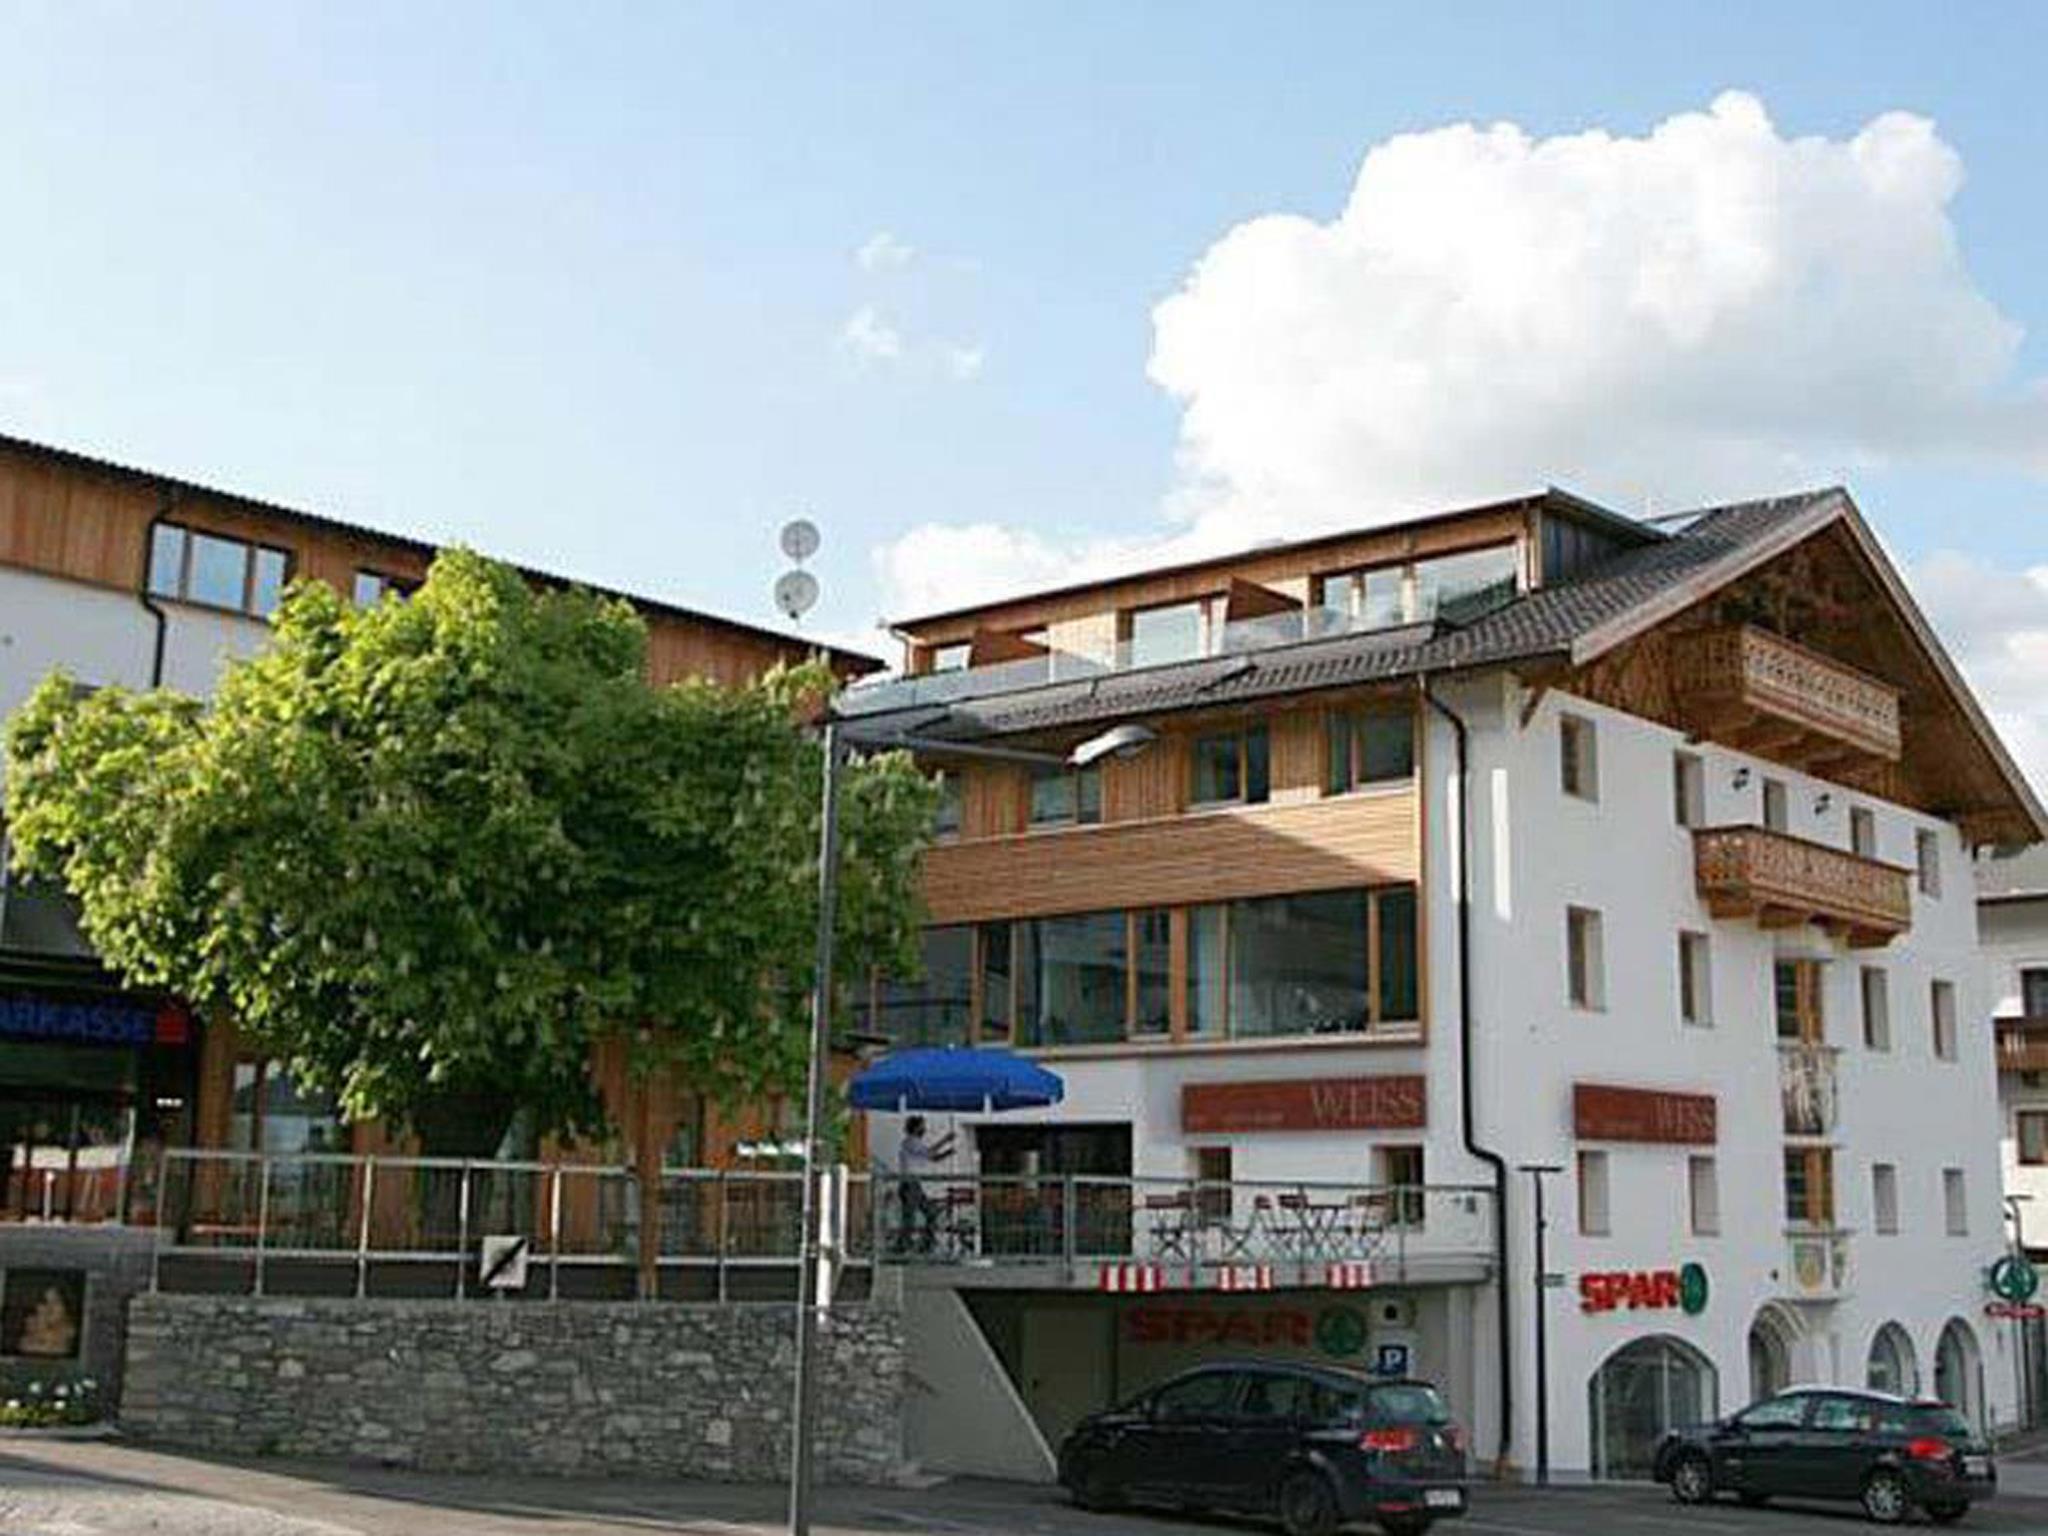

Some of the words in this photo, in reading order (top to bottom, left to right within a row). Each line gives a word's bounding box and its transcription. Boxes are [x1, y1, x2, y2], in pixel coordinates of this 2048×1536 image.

[1580, 1271, 1679, 1312] SPAR
[1128, 1307, 1311, 1346] SPAR
[1385, 1349, 1402, 1371] P
